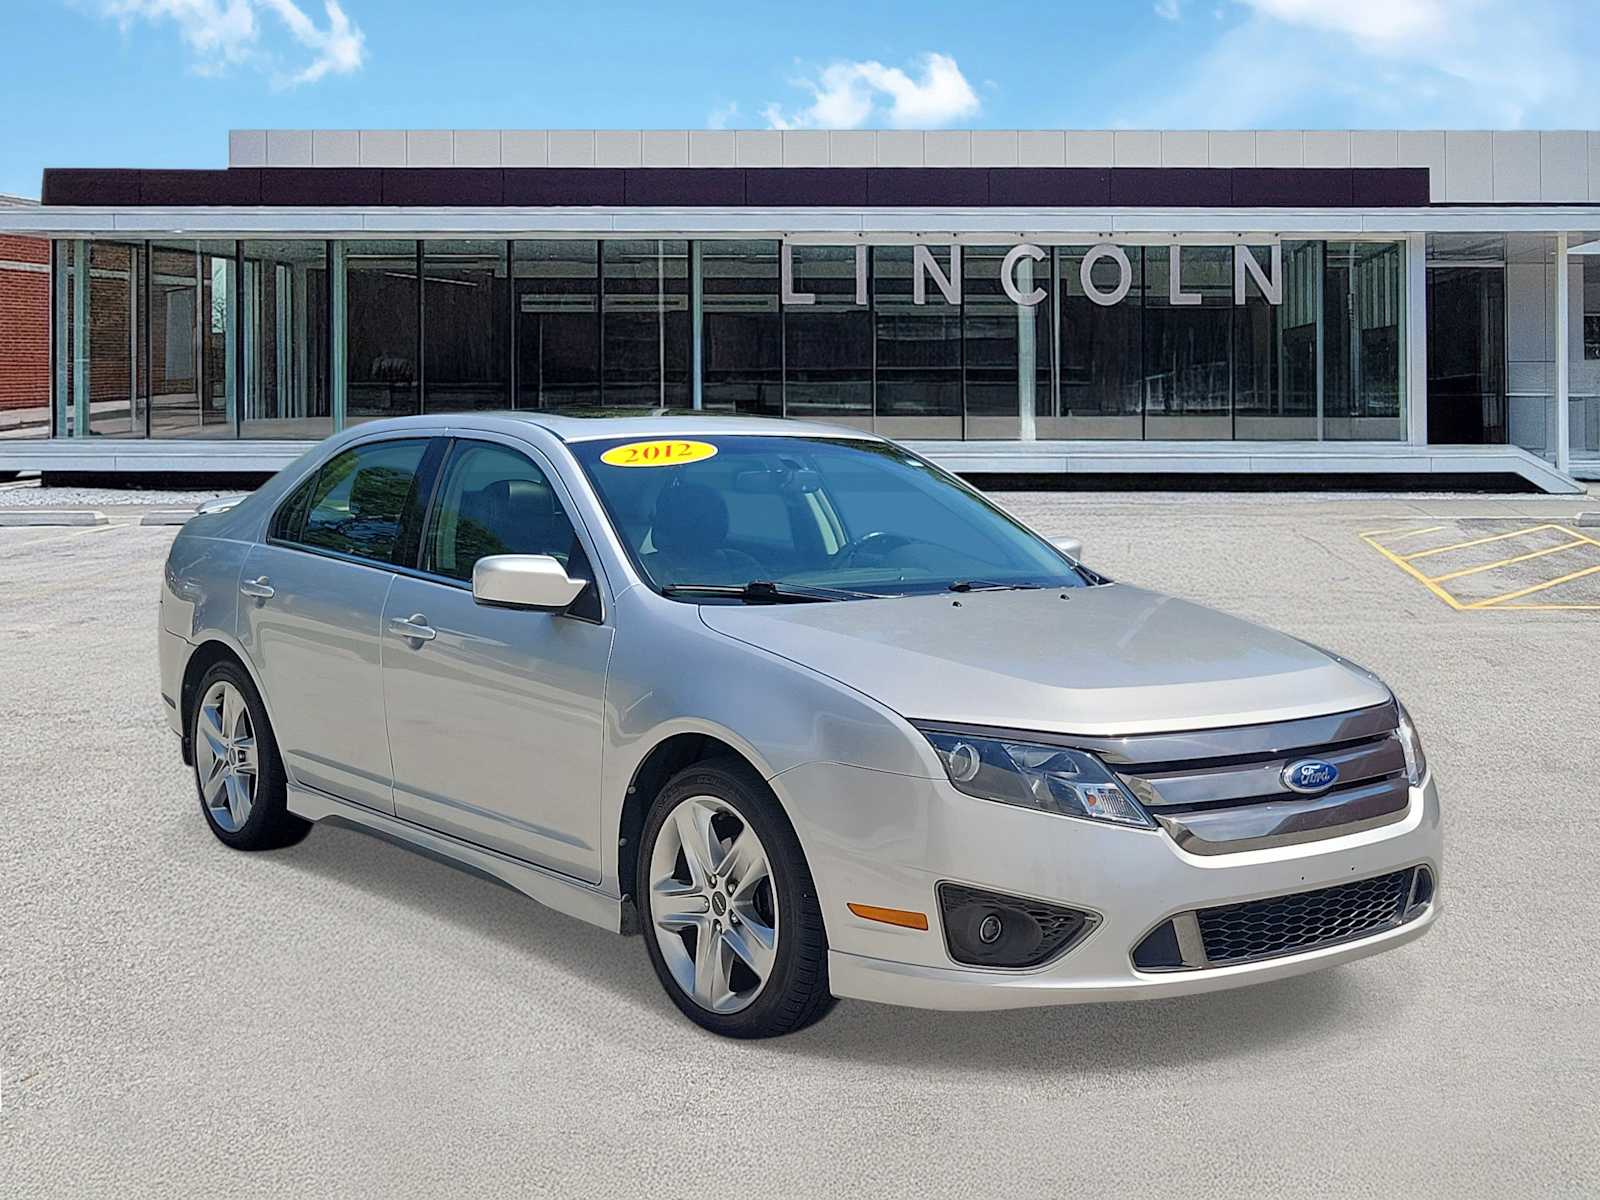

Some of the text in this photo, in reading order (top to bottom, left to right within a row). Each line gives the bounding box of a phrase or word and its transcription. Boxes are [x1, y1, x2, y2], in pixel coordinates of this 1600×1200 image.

[781, 244, 1283, 306] LINCOLN
[624, 443, 692, 463] 2012
[1301, 765, 1330, 785] Ford
